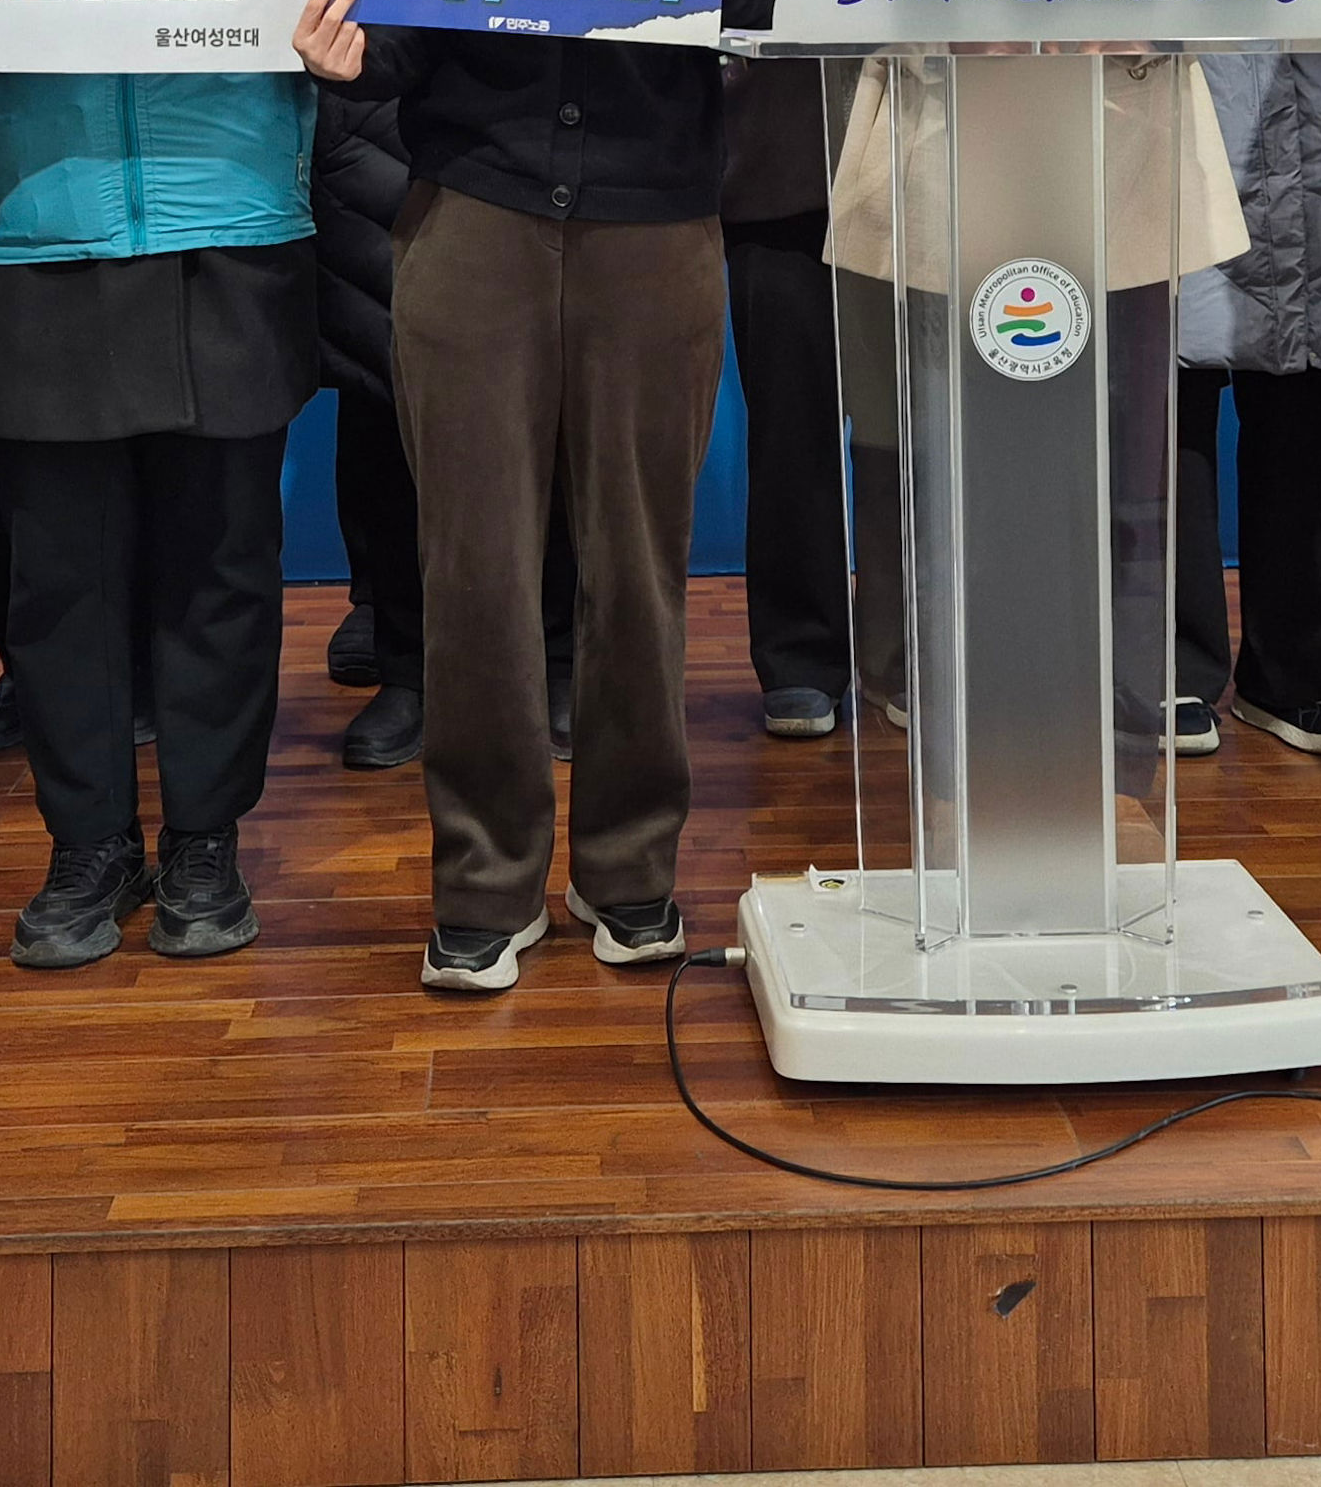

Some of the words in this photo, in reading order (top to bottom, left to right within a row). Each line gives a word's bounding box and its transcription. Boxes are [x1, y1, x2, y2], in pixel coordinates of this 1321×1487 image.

[155, 27, 260, 48] 울산여성연대
[1031, 265, 1059, 281] Office
[1060, 280, 1070, 289] of
[979, 266, 1028, 309] Metropolitan
[976, 311, 987, 338] Ulsan
[1067, 288, 1084, 337] Education
[988, 347, 1073, 375] 울산광역시교육청
